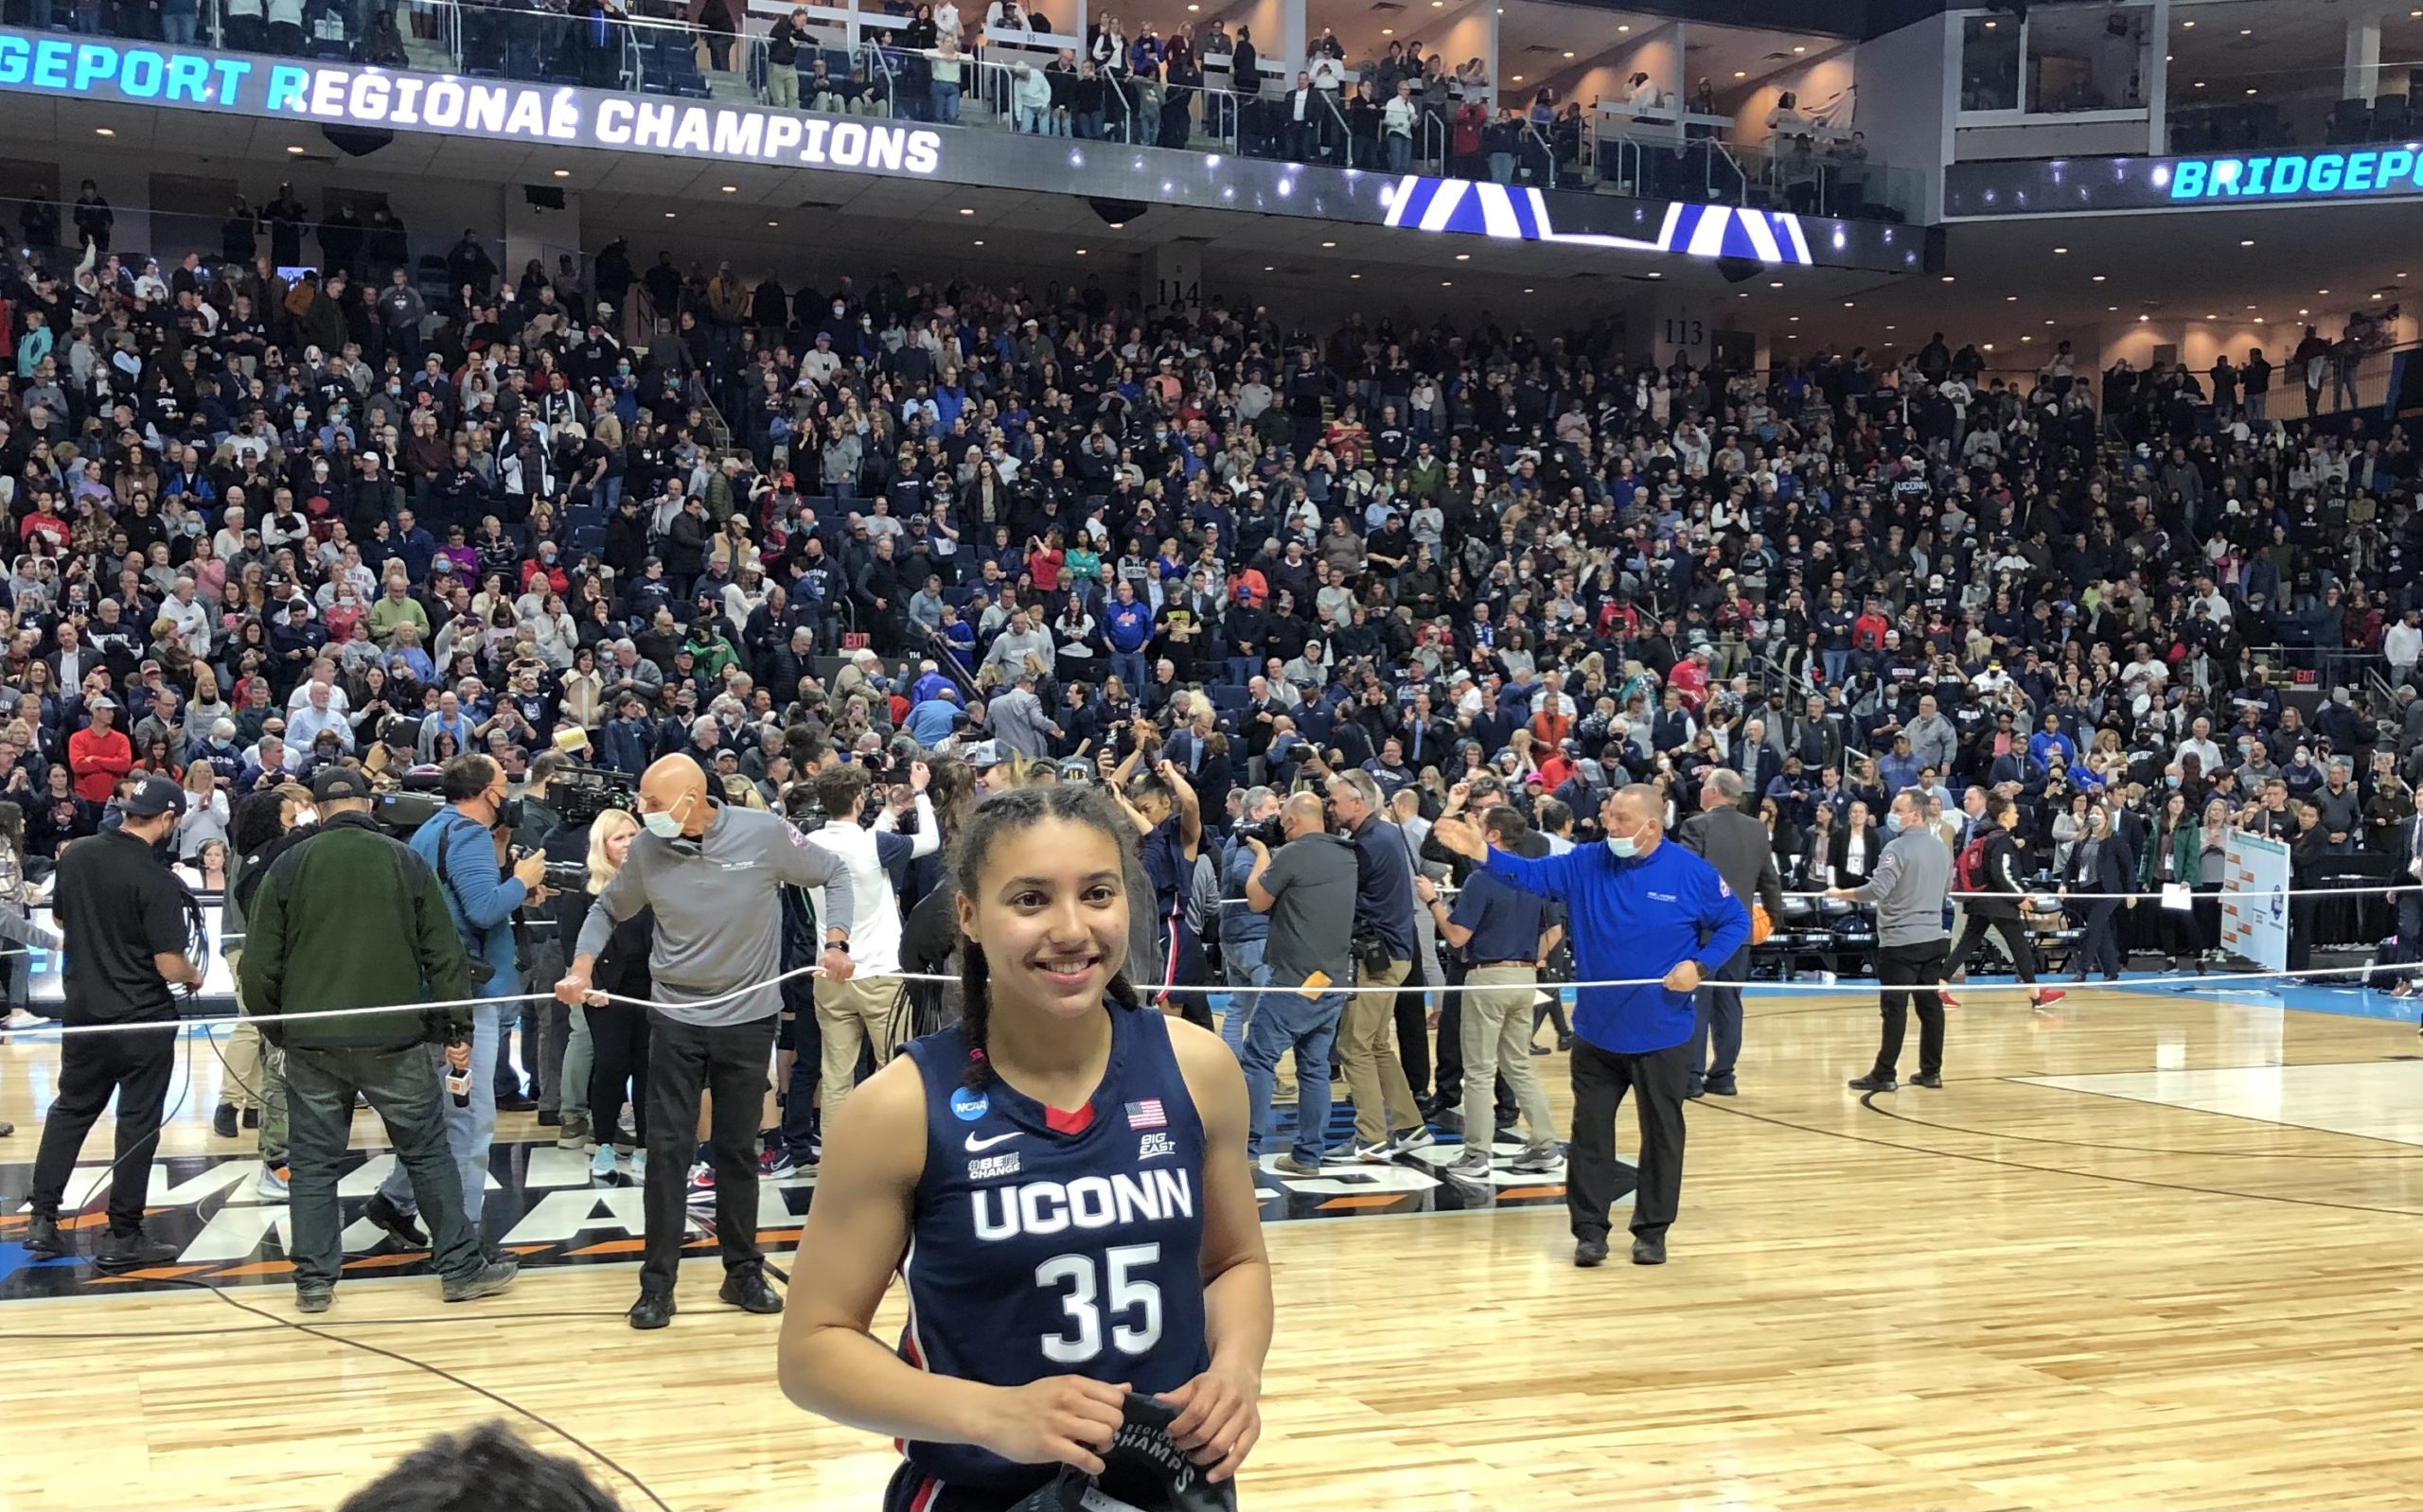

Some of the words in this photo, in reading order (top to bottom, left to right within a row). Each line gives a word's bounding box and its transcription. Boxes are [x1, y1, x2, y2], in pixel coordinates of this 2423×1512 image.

[267, 67, 576, 139] REGIONAL
[595, 99, 941, 174] CHAMPIONS
[2171, 149, 2423, 199] BRIDGEP
[1159, 278, 1200, 308] 114
[1665, 318, 1702, 345] 113
[1898, 481, 1927, 490] UCONN
[845, 633, 867, 648] EXIT
[909, 651, 921, 659] 114
[2296, 669, 2316, 682] EXIT
[956, 1100, 986, 1113] NCAA
[1141, 1133, 1167, 1145] BIG
[1140, 1141, 1176, 1154] EAST
[969, 1163, 1020, 1179] CHANGE
[971, 1169, 1193, 1240] UCONN
[1035, 1241, 1163, 1363] 35
